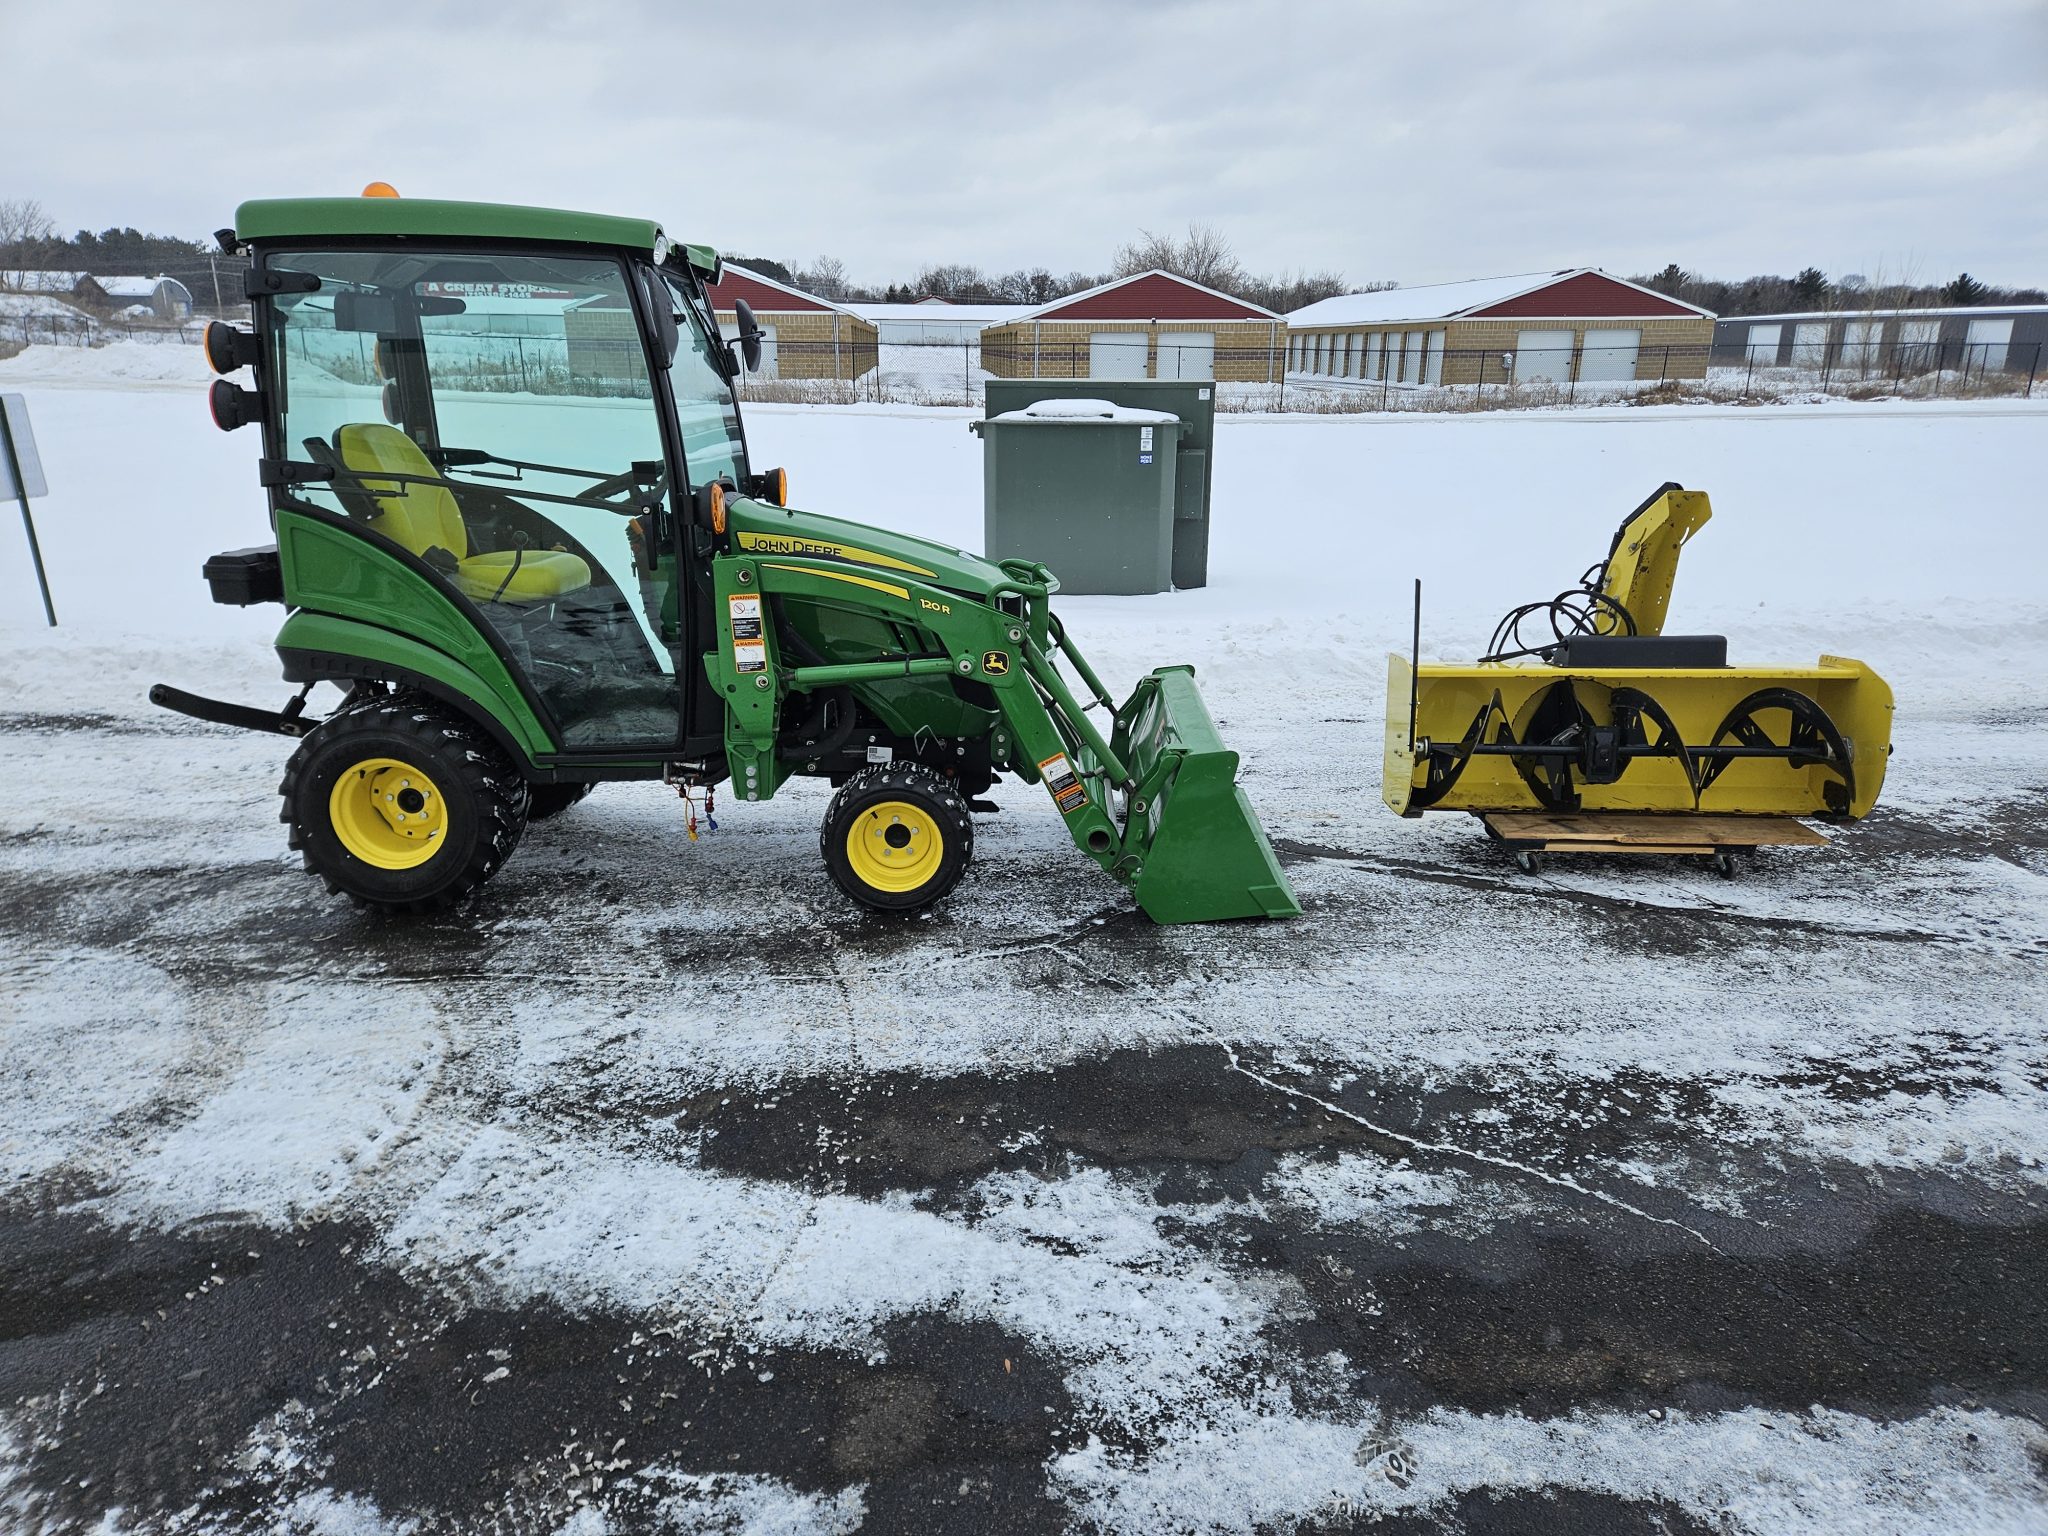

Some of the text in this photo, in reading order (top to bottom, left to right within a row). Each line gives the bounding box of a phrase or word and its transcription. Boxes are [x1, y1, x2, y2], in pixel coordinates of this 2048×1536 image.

[428, 283, 440, 292] A
[443, 282, 493, 293] GREAT
[749, 537, 842, 556] JOHN DEERE
[920, 598, 951, 615] 120 R
